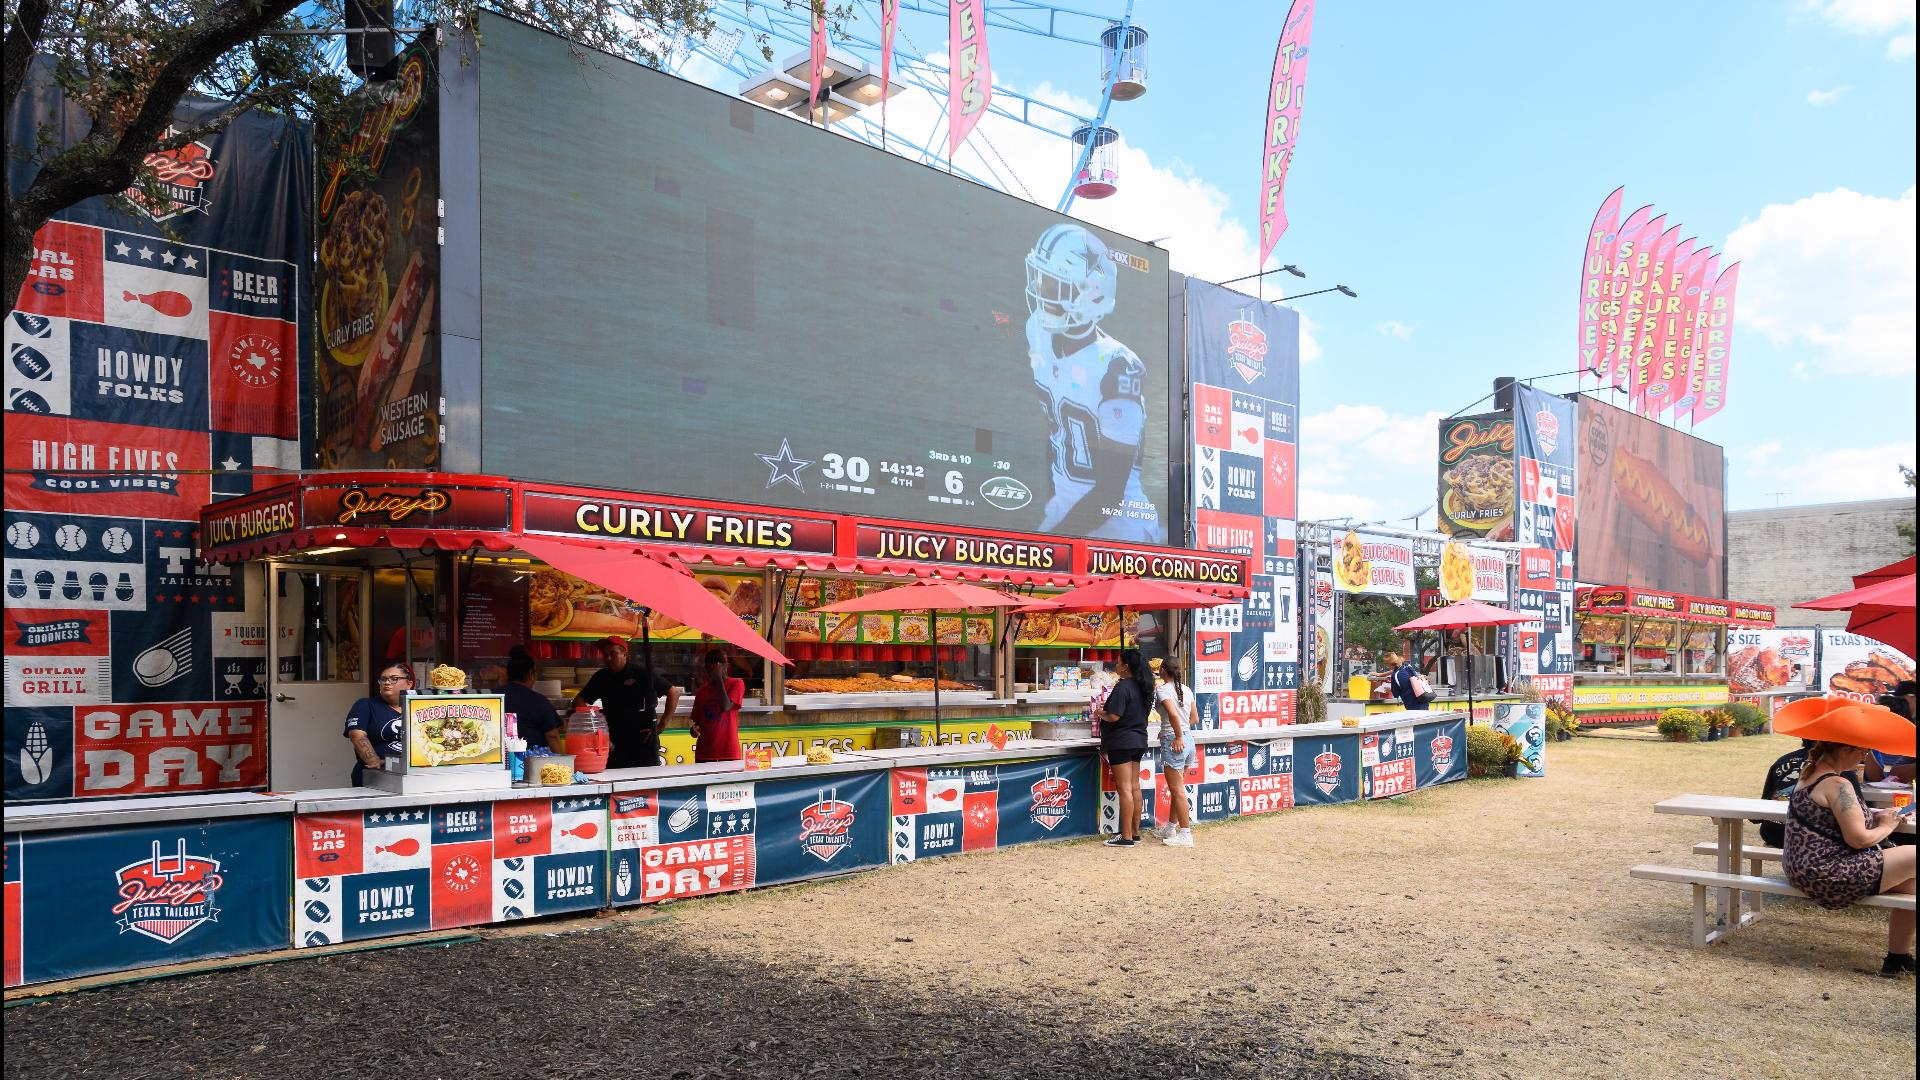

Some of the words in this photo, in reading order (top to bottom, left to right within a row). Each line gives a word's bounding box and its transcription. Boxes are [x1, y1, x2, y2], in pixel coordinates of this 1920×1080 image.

[1262, 42, 1296, 249] TURKEY
[233, 270, 278, 296] BEER
[233, 292, 278, 304] HAVEN
[1582, 231, 1605, 368] TURKEY
[1616, 252, 1650, 379] BURGERS
[1636, 261, 1665, 385] SAUSAGE
[326, 323, 350, 350] CURLY
[352, 312, 374, 337] FRIES
[1661, 273, 1684, 381] FRIES
[1691, 289, 1711, 392] FRIES
[1704, 297, 1728, 410] BURGERS
[97, 347, 183, 386] HOWDY
[98, 381, 184, 403] FOLKS
[380, 391, 428, 422] WESTERN
[1204, 404, 1222, 415] DAL
[1271, 411, 1287, 427] BEER
[380, 415, 425, 446] SAUSAGE
[33, 440, 95, 470] HIGH
[109, 446, 178, 480] FIVES
[929, 450, 949, 461] 3RD
[959, 455, 972, 465] 10
[993, 460, 1011, 471] :30
[822, 453, 870, 483] 30
[880, 460, 925, 478] 14:12
[1228, 466, 1256, 488] HOWDY
[46, 478, 100, 490] COOL
[110, 478, 170, 490] VIBES
[890, 477, 913, 487] 4TH
[944, 470, 964, 495] 6
[985, 485, 1027, 500] JETS
[1227, 486, 1256, 500] FOLKS
[1128, 501, 1155, 511] FIELDS
[1449, 508, 1477, 520] CURLY
[1480, 508, 1504, 519] FRIES
[209, 513, 237, 547] JUICY
[241, 501, 294, 538] BURGERS
[1140, 511, 1155, 520] YDS
[576, 504, 695, 539] CURLY
[706, 516, 792, 547] FRIES
[1207, 525, 1227, 546] HIGH
[1230, 529, 1254, 549] FIVES
[877, 532, 947, 560] JUICY
[955, 539, 1054, 569] BURGERS
[1360, 544, 1411, 566] ZUCCHINI
[1091, 551, 1147, 575] JUMBO
[1152, 558, 1195, 579] CORN
[1200, 563, 1238, 583] DOGS
[1475, 558, 1504, 573] ONION
[160, 577, 232, 586] TAILGATE
[1371, 567, 1405, 586] CURLS
[1476, 574, 1505, 591] RINGS
[1637, 595, 1657, 607] CURLY
[1659, 597, 1675, 609] FRIES
[1705, 604, 1728, 616] BURGERS
[28, 621, 80, 634] GRILLED
[27, 630, 81, 644] GOODNESS
[1738, 634, 1761, 645] SIZE
[1829, 635, 1860, 646] TEXAS
[22, 667, 86, 675] OUTLAW
[22, 680, 86, 694] GRILL
[1222, 693, 1277, 714] GAME
[416, 707, 447, 723] TACOS
[447, 705, 459, 717] DE
[461, 706, 492, 721] ASADA
[84, 707, 253, 740] GAME
[84, 743, 253, 790] DAY
[1242, 777, 1280, 792] GAME
[1374, 777, 1405, 795] DAY
[1242, 792, 1281, 812] DAY
[446, 810, 477, 827] BEER
[509, 815, 537, 825] DAL
[312, 829, 345, 841] DAL
[447, 826, 477, 834] HAVEN
[509, 824, 538, 834] LAS
[617, 832, 647, 842] GRILL
[924, 823, 954, 841] HOWDY
[312, 840, 345, 851] LAS
[924, 839, 954, 850] FOLKS
[645, 842, 729, 868] GAME
[547, 865, 593, 888] HOWDY
[645, 864, 729, 898] DAY
[359, 884, 415, 910] HOWDY
[547, 885, 594, 899] FOLKS
[132, 906, 161, 919] TEXAS
[165, 904, 205, 918] TAILGATE
[359, 907, 415, 923] FOLKS
